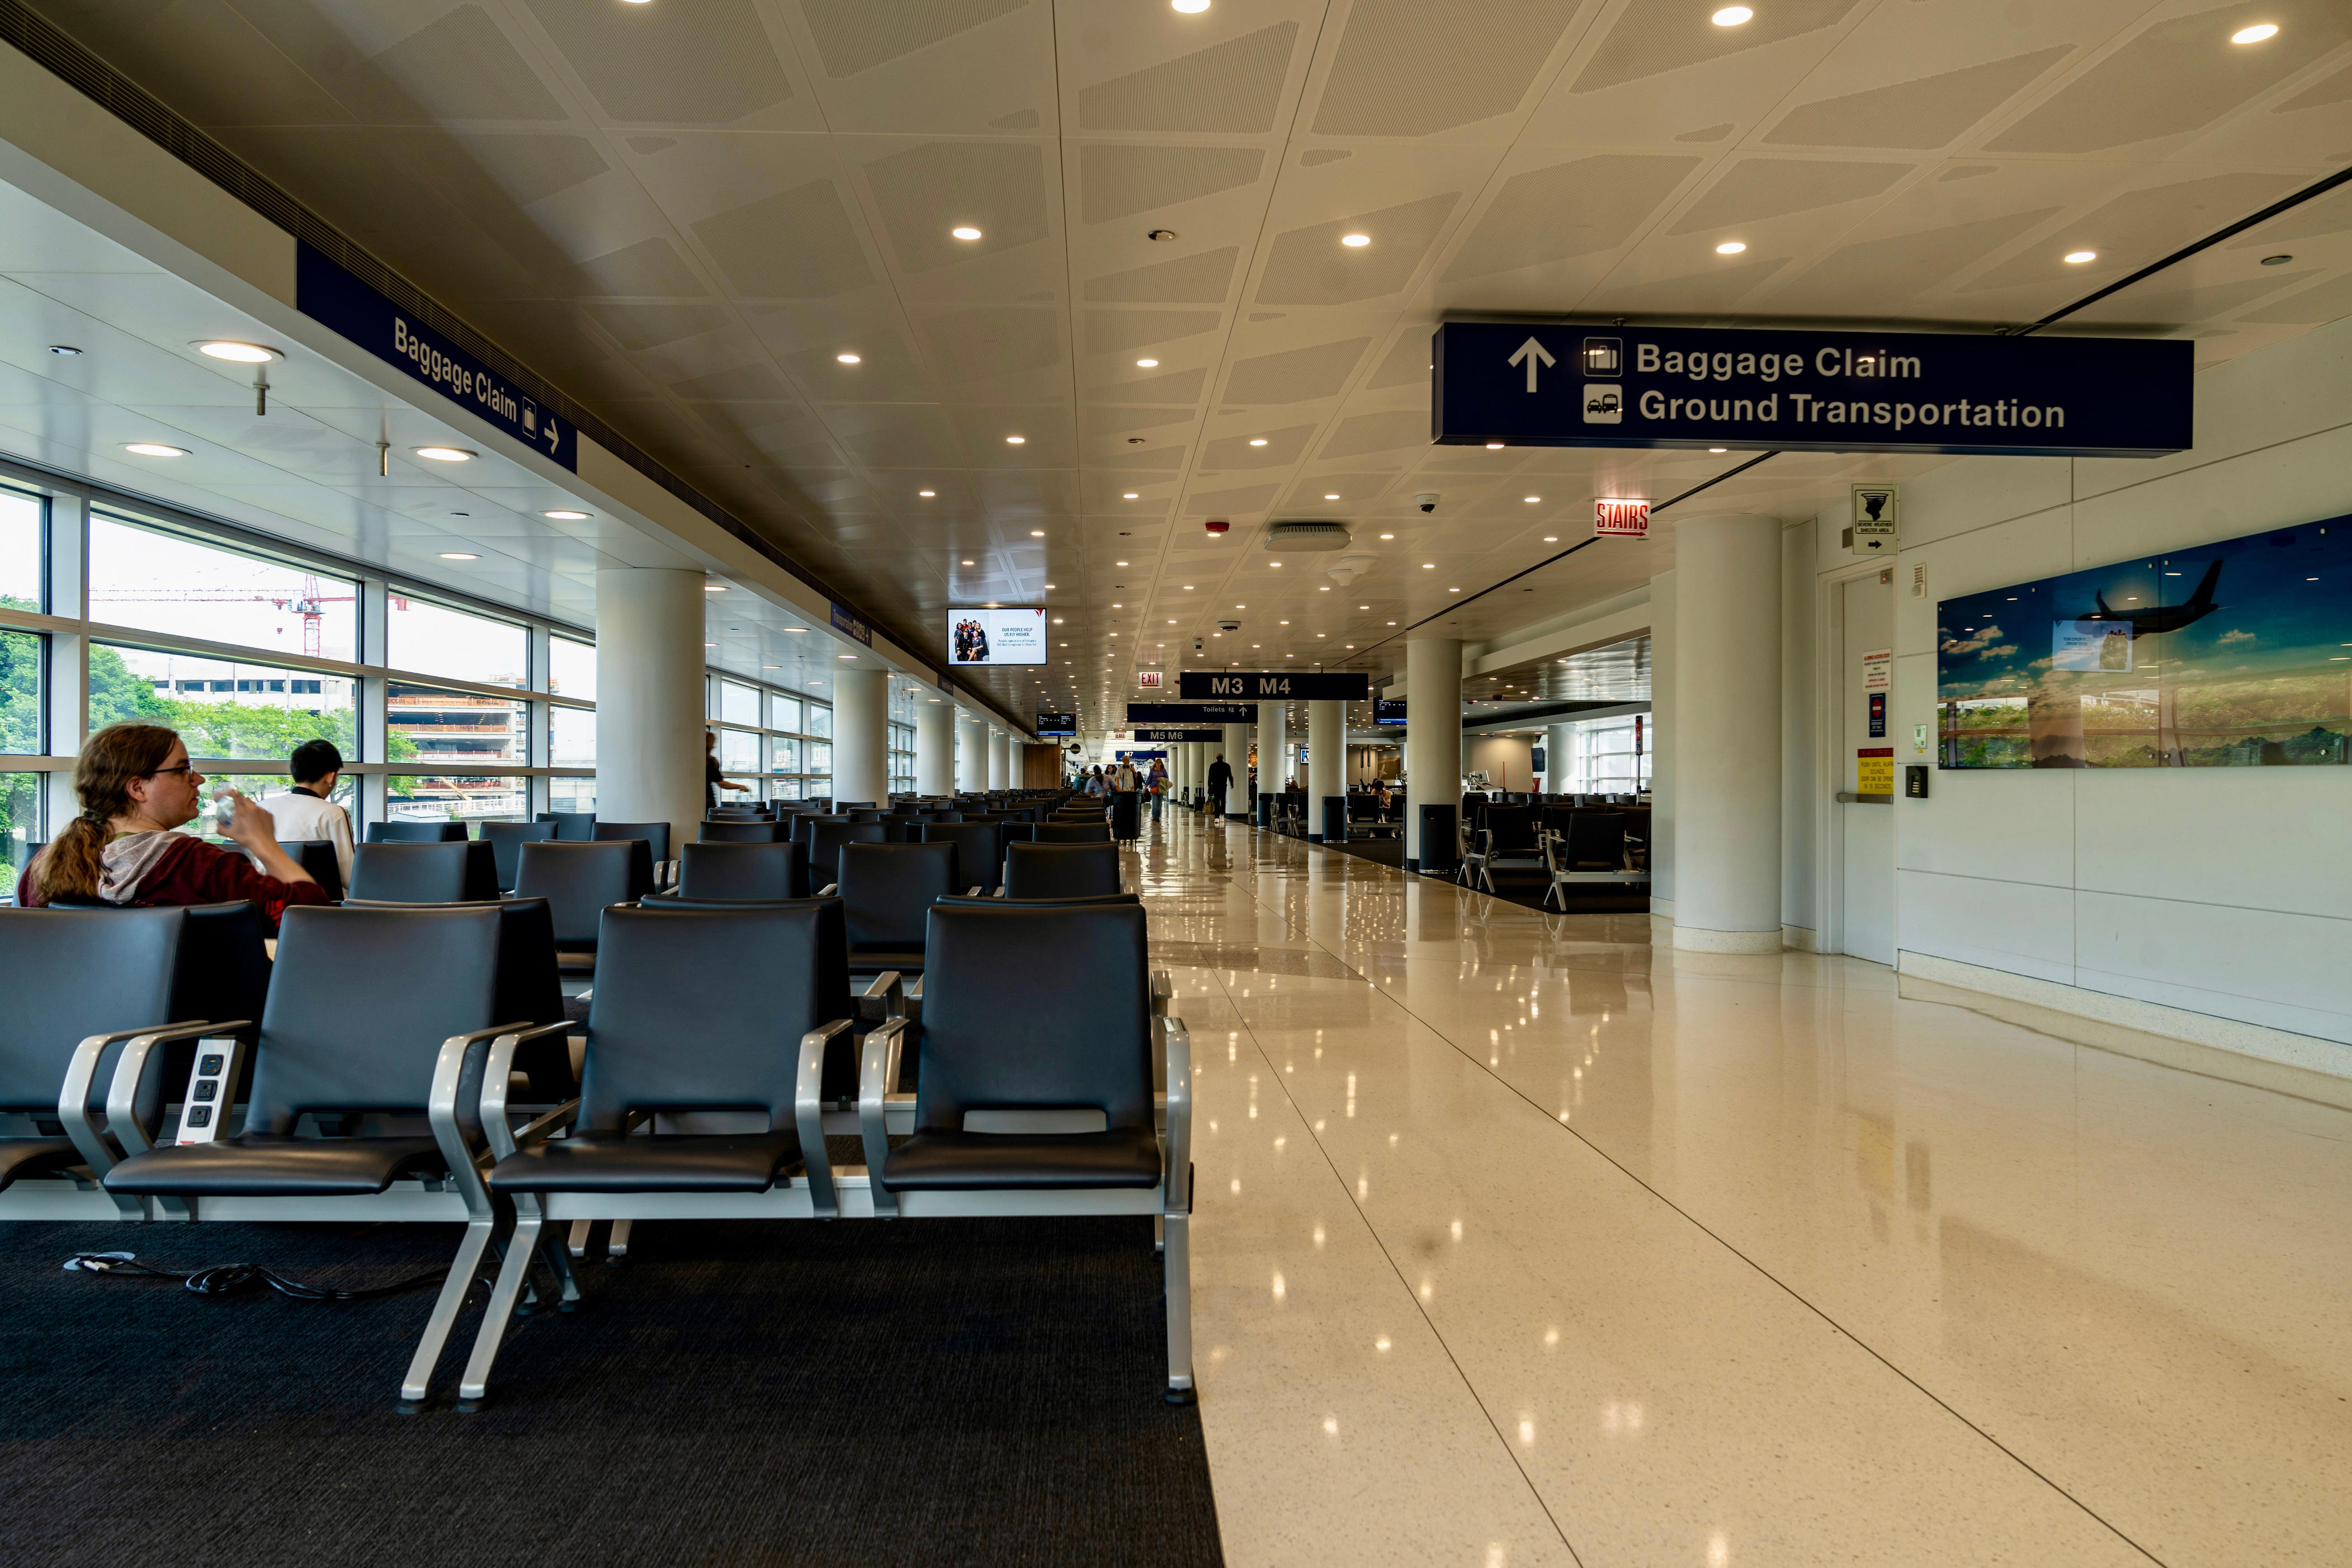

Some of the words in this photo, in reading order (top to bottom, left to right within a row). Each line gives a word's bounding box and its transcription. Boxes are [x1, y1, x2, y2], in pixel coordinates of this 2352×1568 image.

[395, 316, 473, 395] Baggage
[475, 372, 517, 423] Claim
[1636, 343, 1804, 382] Baggage
[1815, 347, 1921, 378] Claim
[1639, 390, 1778, 422] Ground
[1789, 393, 2065, 431] Transportation
[1597, 503, 1647, 530] STAIRS
[1142, 673, 1160, 684] EXIT
[1212, 678, 1243, 694] M3
[1259, 678, 1291, 694] M4
[1150, 731, 1165, 740] M5
[1168, 731, 1183, 740] M6
